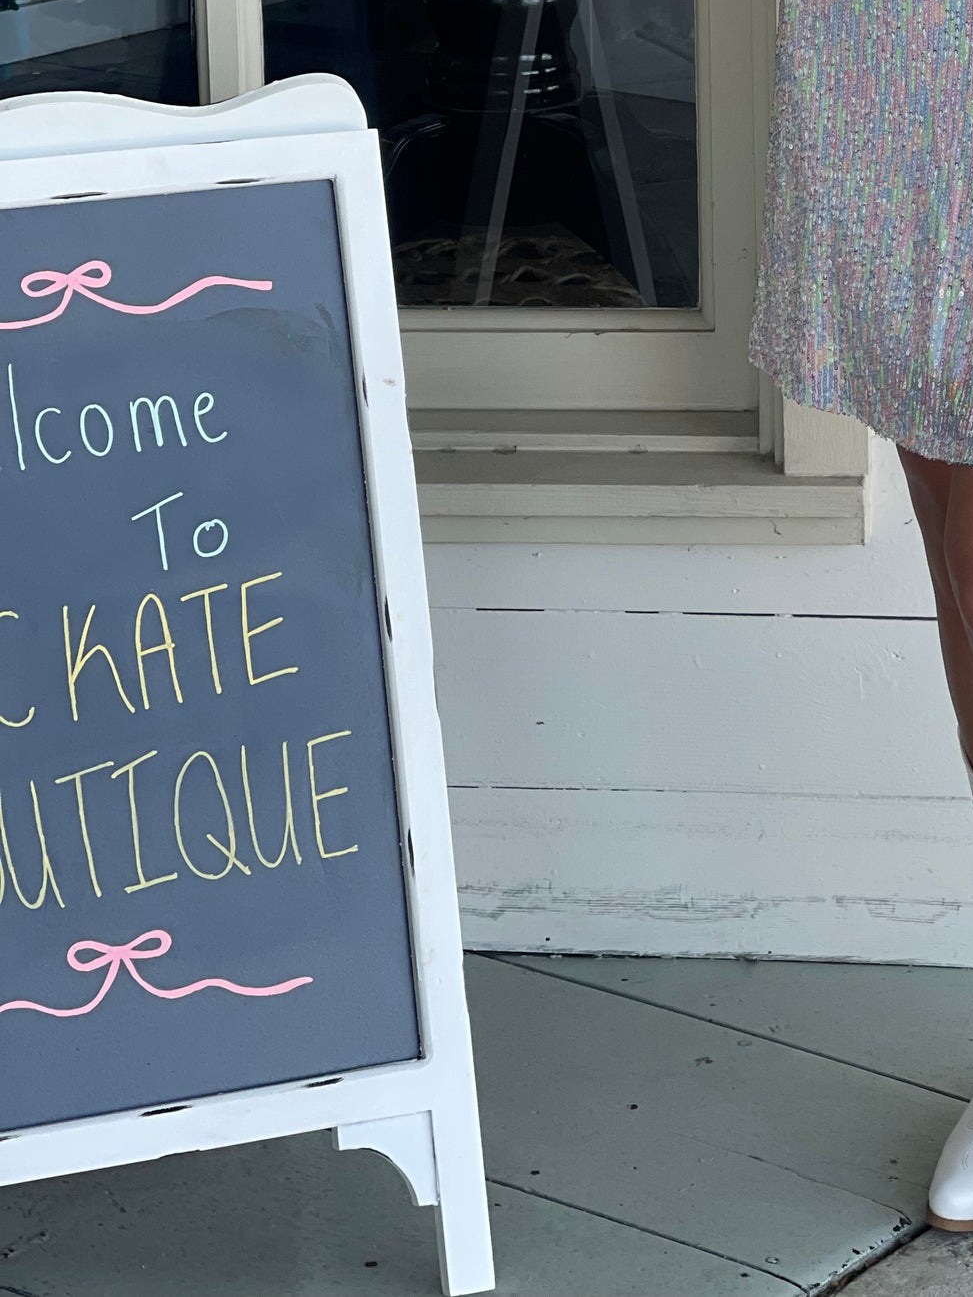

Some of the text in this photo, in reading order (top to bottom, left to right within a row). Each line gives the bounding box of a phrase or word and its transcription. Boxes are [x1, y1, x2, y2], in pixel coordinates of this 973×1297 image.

[8, 363, 228, 471] lcome
[132, 492, 229, 571] To
[63, 571, 299, 721] KATE
[0, 729, 359, 910] UTIQUE
